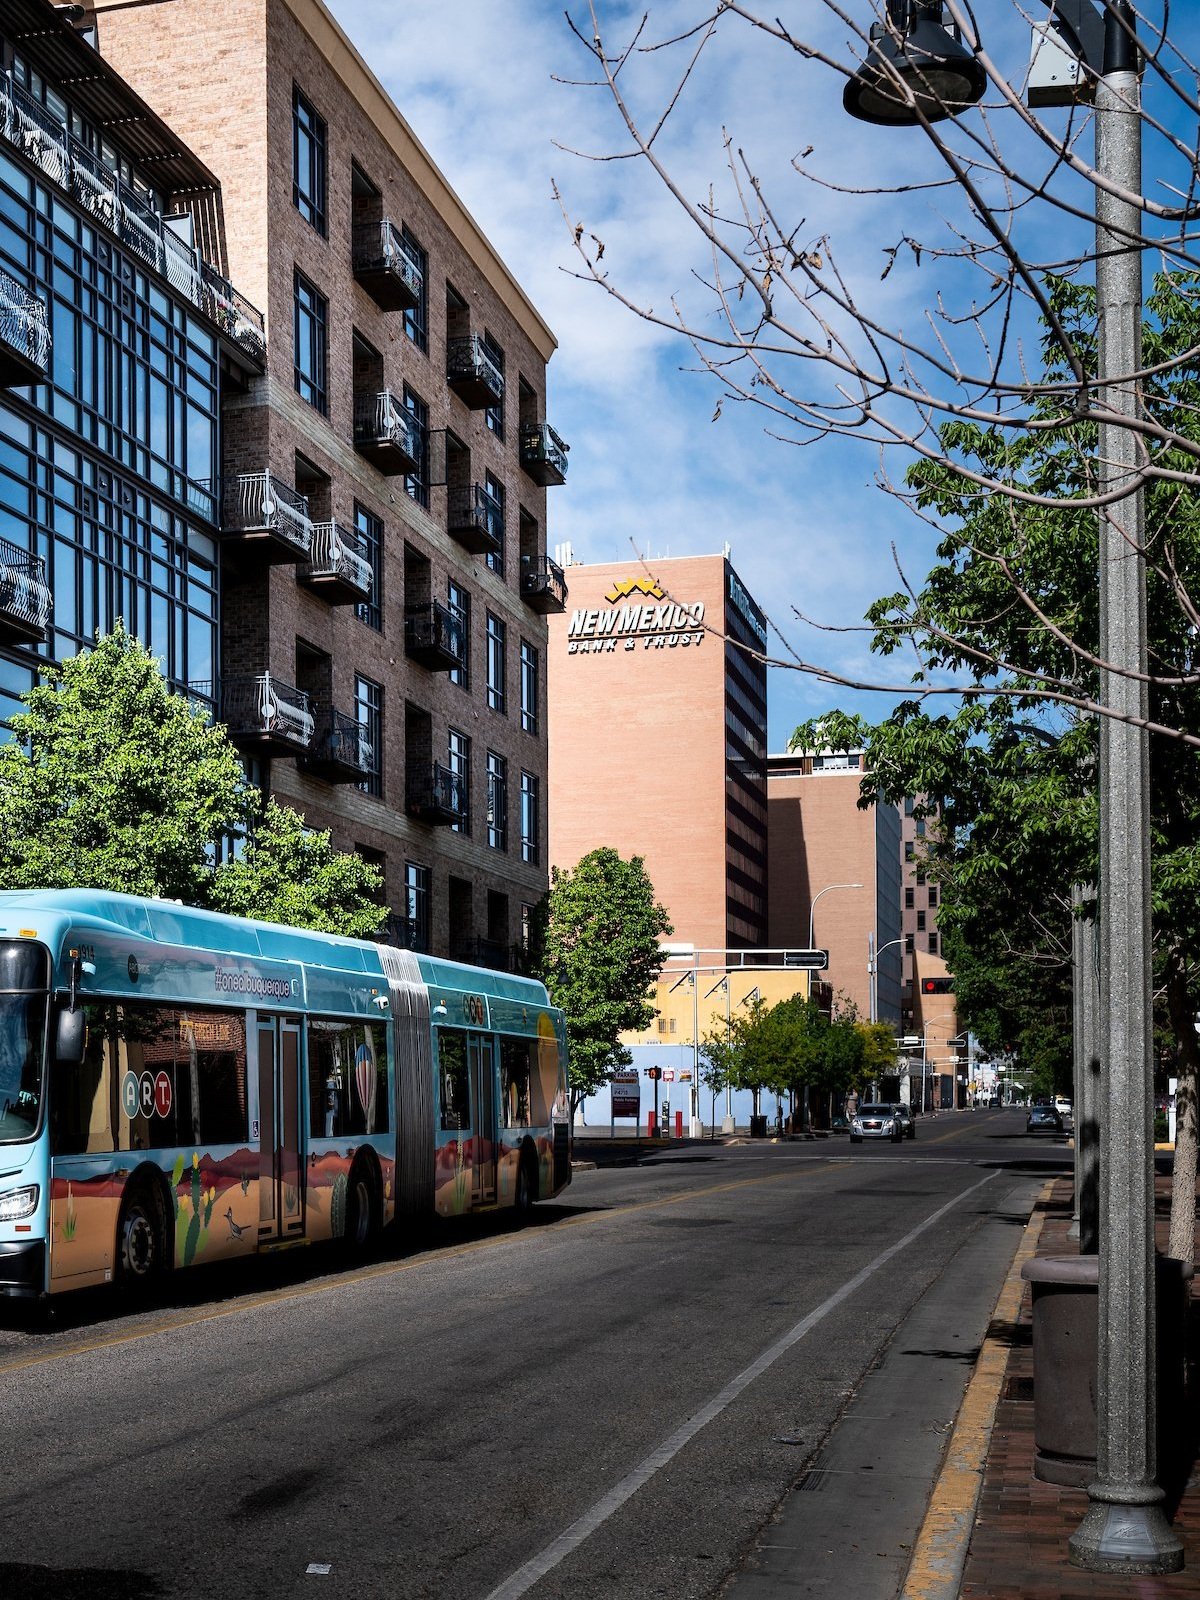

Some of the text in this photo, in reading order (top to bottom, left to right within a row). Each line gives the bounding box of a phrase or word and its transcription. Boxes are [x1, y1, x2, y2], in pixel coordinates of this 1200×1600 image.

[568, 609, 620, 637] NEW
[618, 601, 705, 634] MEXICO
[568, 632, 705, 655] BANK & TRUST
[125, 1078, 169, 1109] ART
